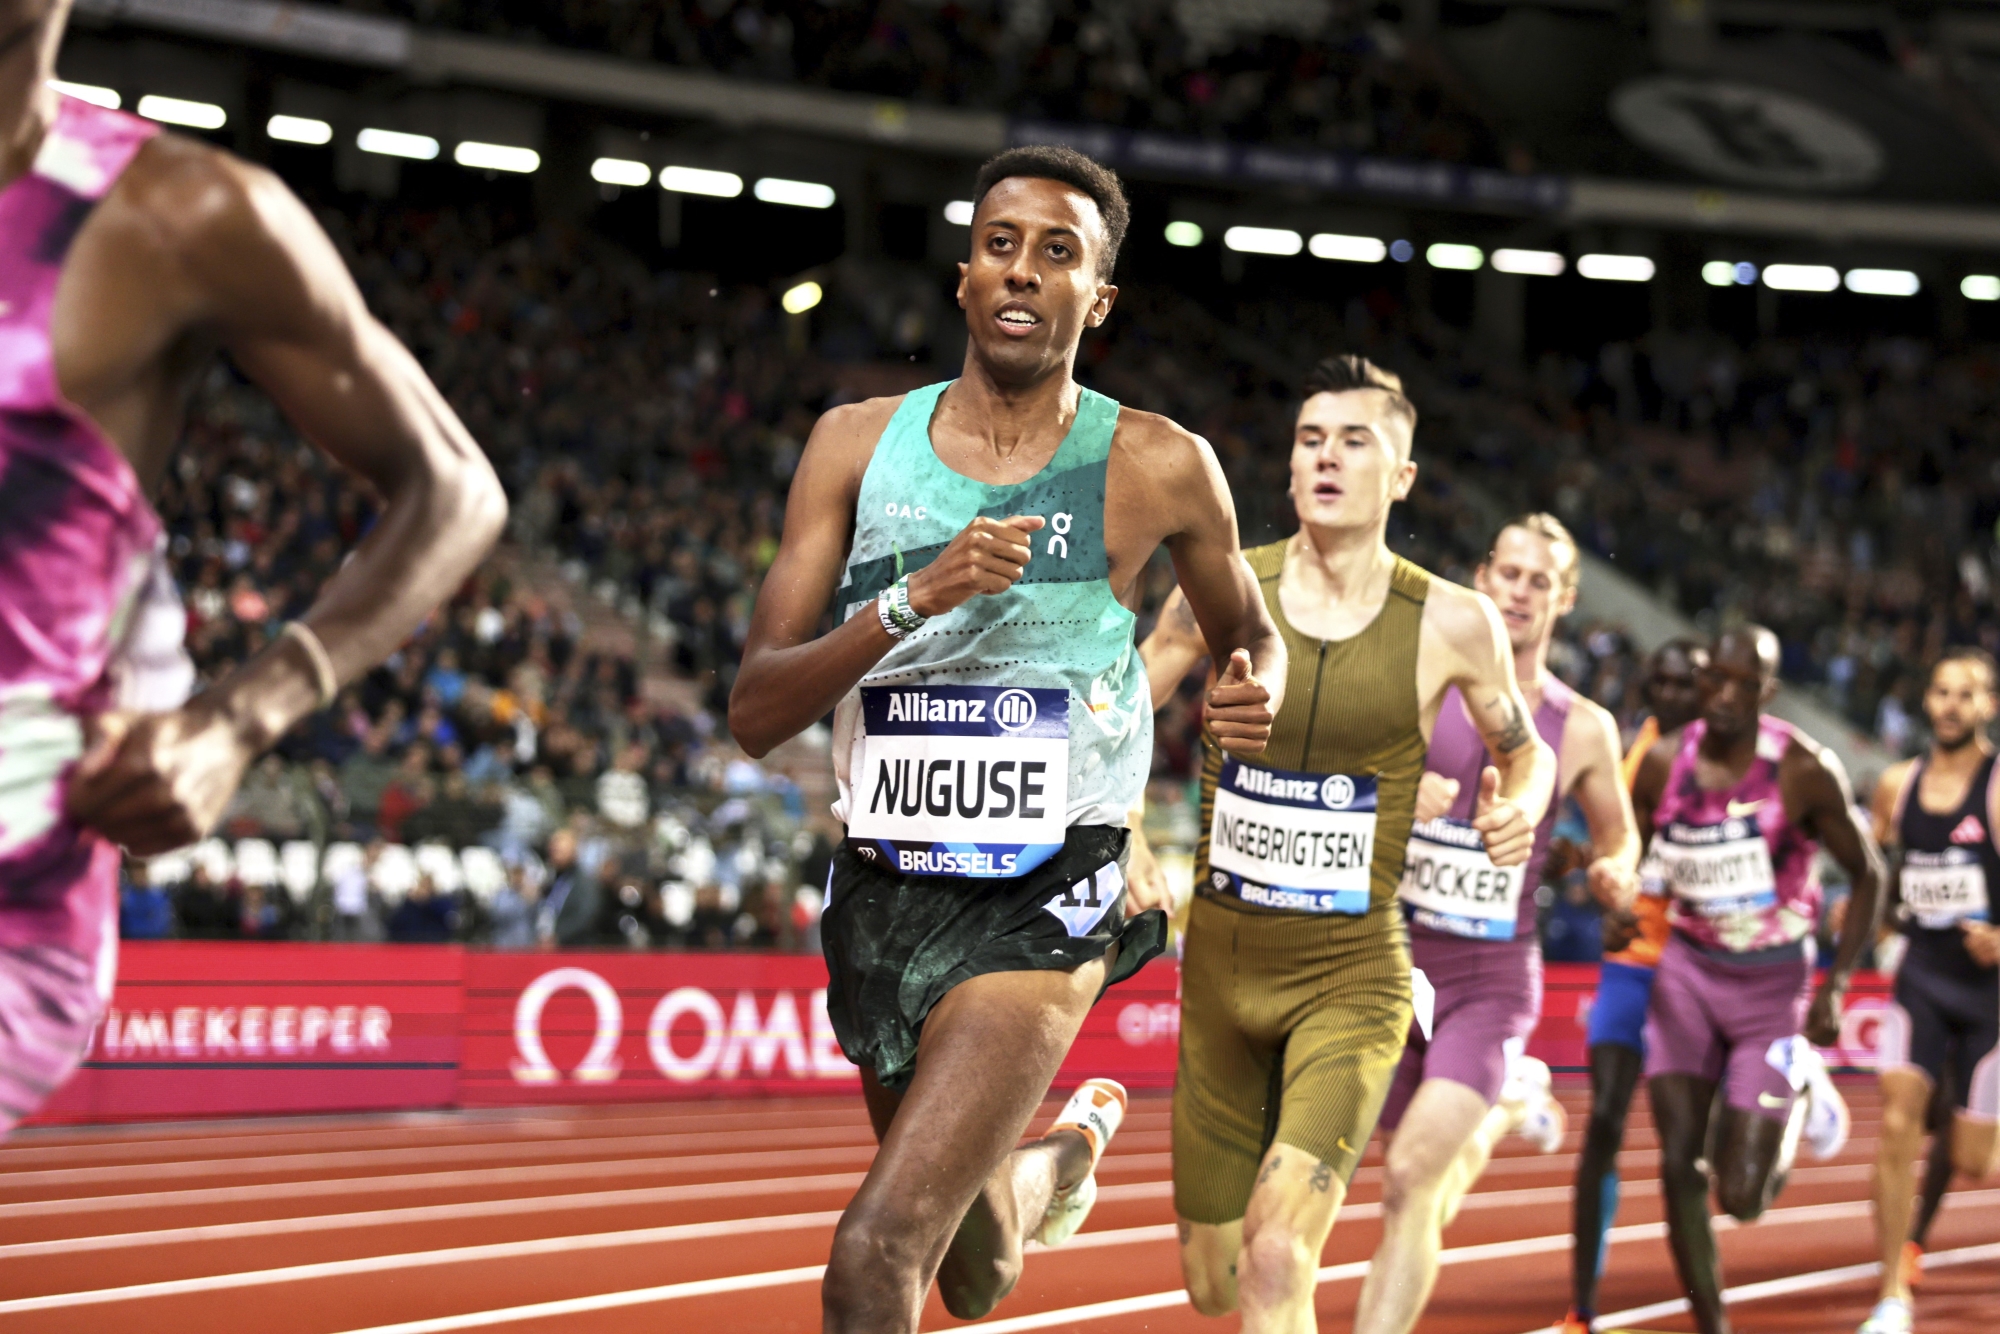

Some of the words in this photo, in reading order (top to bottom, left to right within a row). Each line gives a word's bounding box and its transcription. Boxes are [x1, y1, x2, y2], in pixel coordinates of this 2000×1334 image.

[885, 502, 927, 520] OAC
[887, 692, 986, 723] Allianz
[869, 758, 1047, 819] NUGUSE
[1234, 764, 1318, 802] Allianz
[1215, 810, 1367, 869] INGEBRIGTSEN
[899, 850, 1017, 875] BRUSSELS
[1403, 853, 1510, 903] HOCKER
[1240, 882, 1334, 911] BRUSSELS
[86, 1005, 392, 1057] IMEKEEPER
